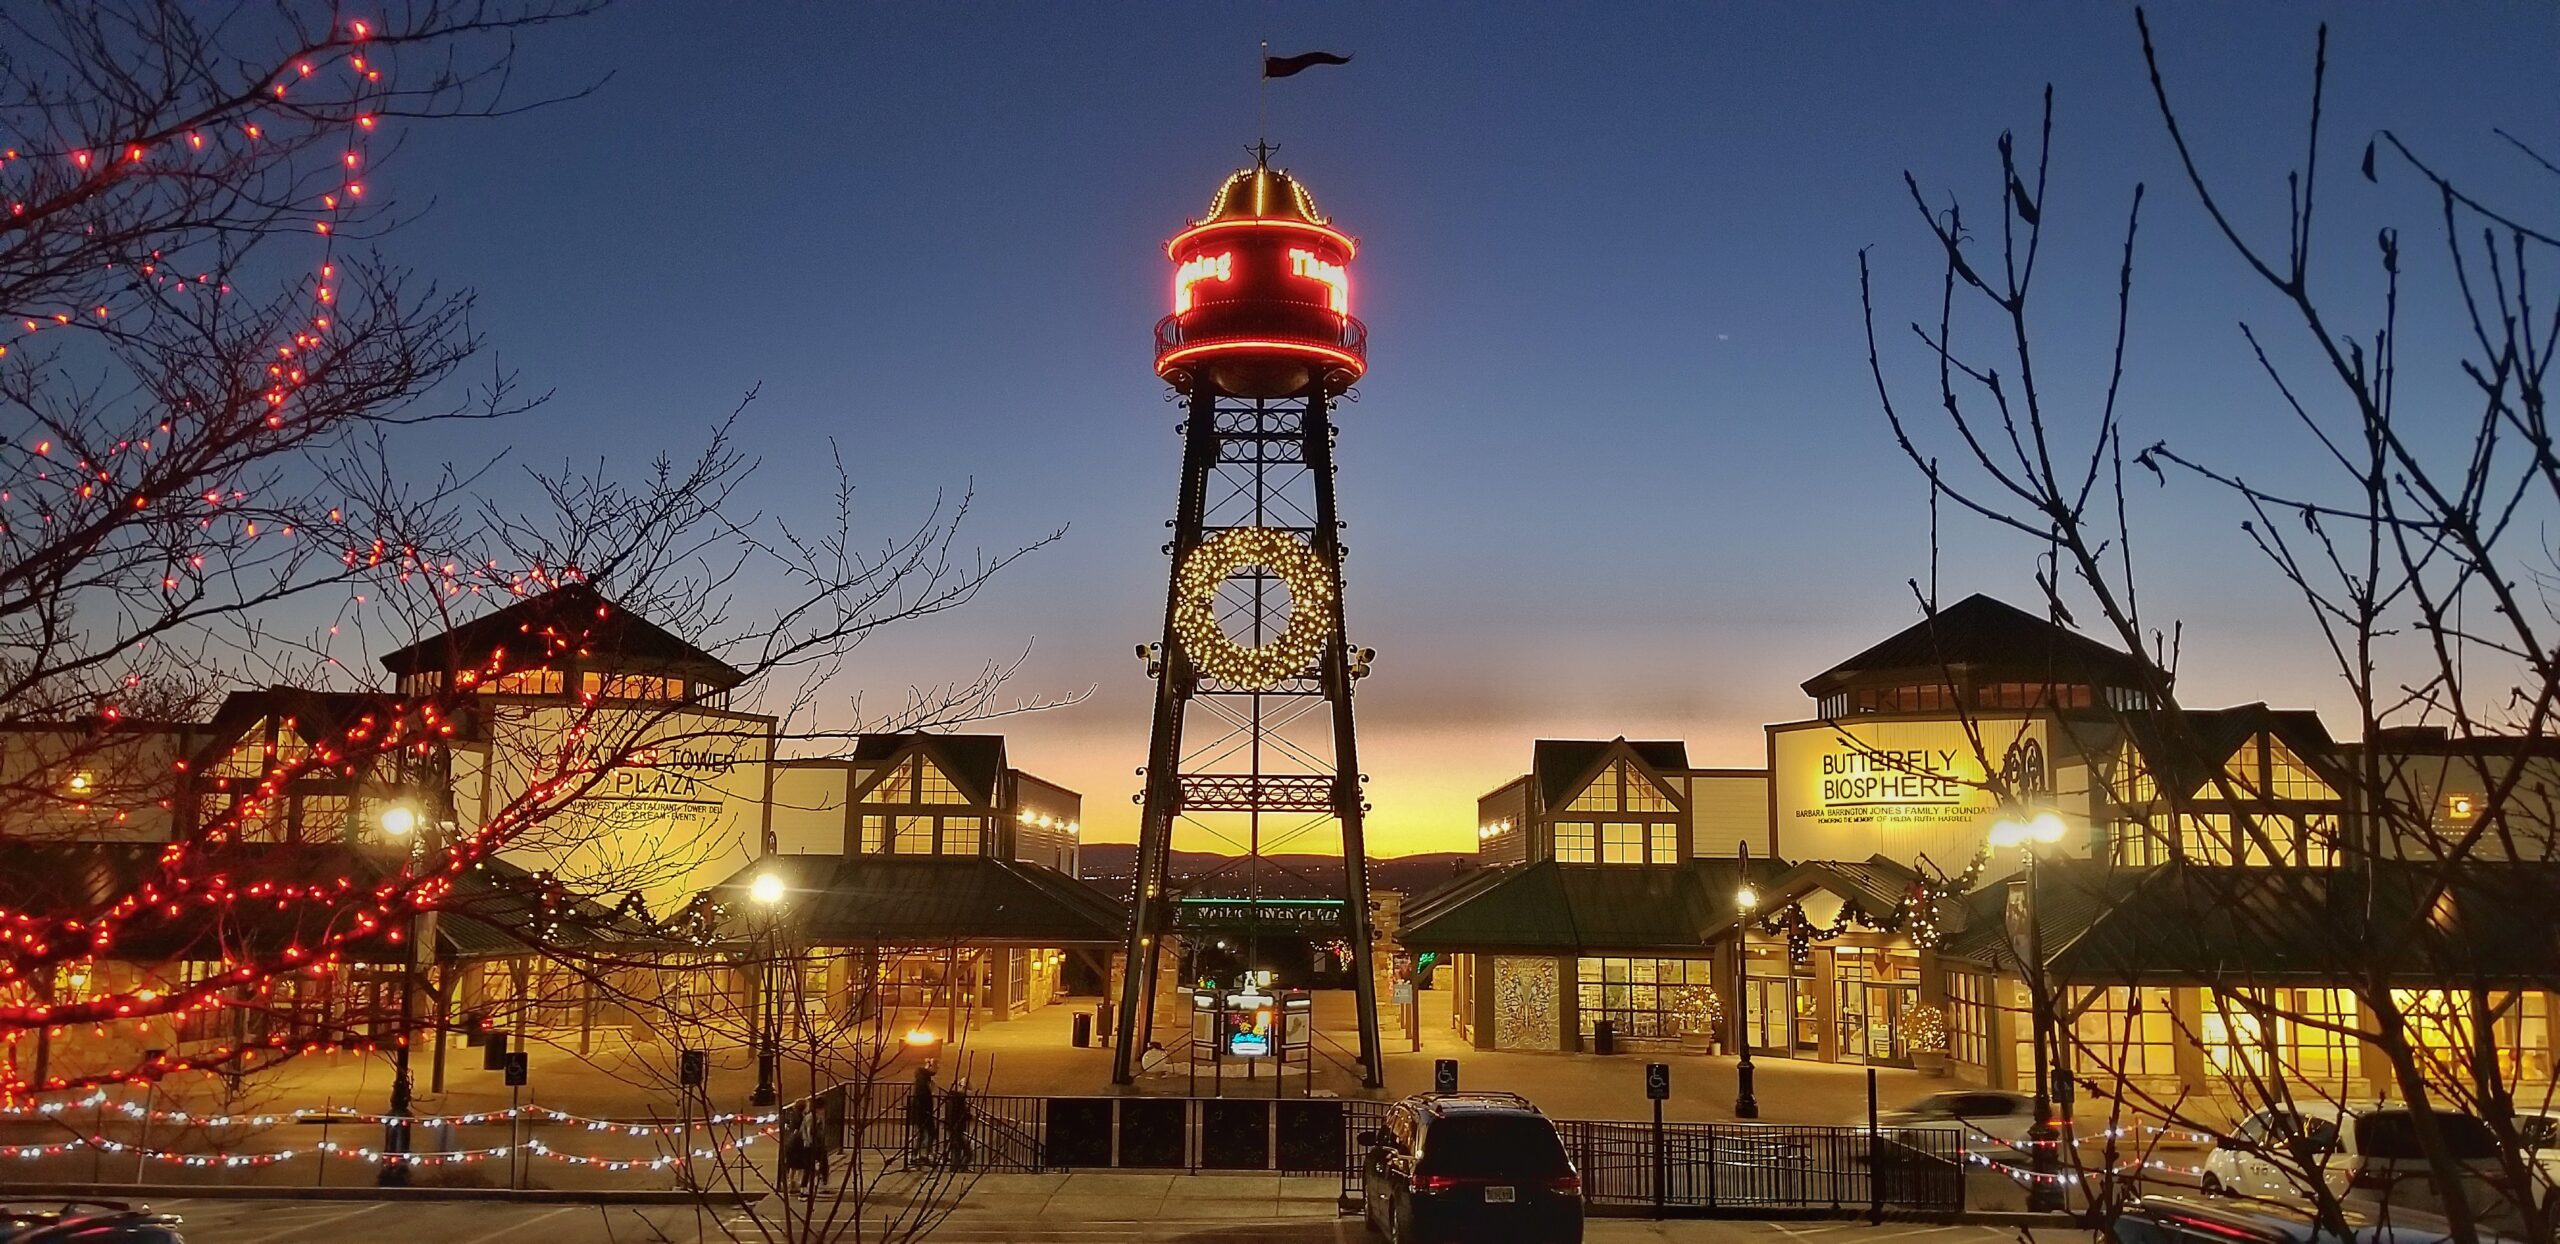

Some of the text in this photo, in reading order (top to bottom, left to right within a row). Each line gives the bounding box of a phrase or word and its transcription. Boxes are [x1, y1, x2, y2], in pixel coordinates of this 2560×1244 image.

[670, 747, 735, 774] TOWER
[1823, 749, 1957, 775] BUTTERFLY
[616, 772, 696, 796] PLAZA
[1824, 775, 1960, 800] BIOSPHERE
[1795, 809, 1824, 817] BARBARA
[1827, 807, 1868, 816] BARRINGTON
[1870, 807, 1902, 815] JONES
[1905, 806, 1939, 815] FAMILY
